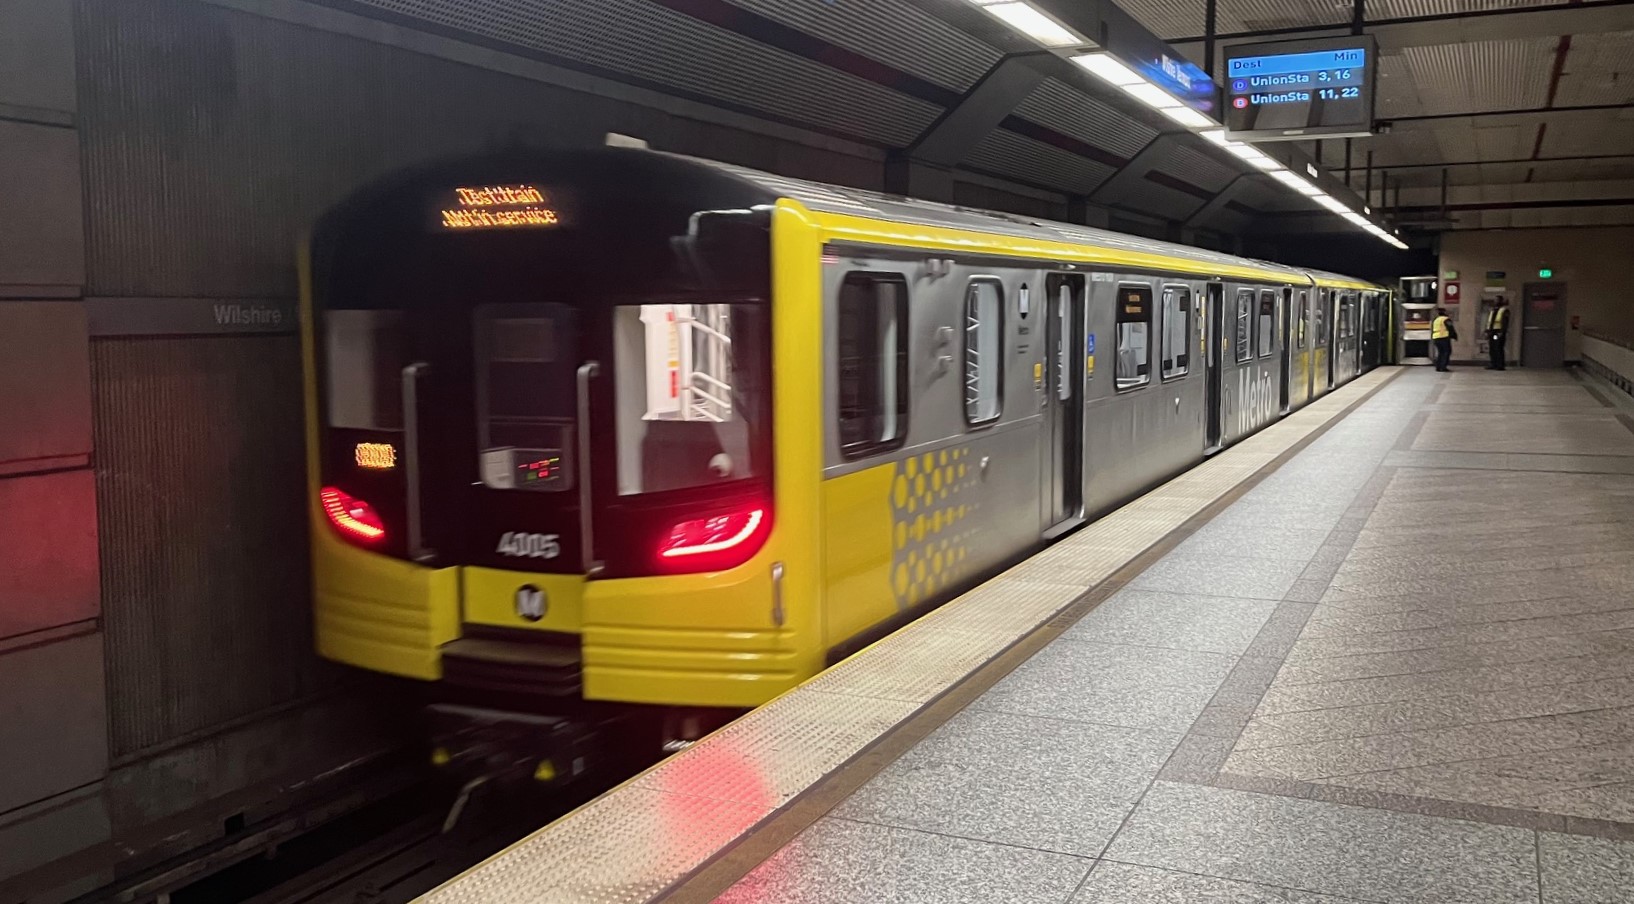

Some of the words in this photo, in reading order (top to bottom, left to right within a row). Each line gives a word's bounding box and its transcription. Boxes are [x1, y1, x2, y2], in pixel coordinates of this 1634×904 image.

[1233, 60, 1262, 69] Dest
[1334, 52, 1358, 61] Min
[1250, 73, 1310, 86] UnionSta
[1318, 72, 1331, 82] 3,
[1334, 69, 1351, 79] 16
[1250, 92, 1310, 104] UnionSta
[1319, 89, 1339, 99] 11,
[1341, 87, 1359, 98] 22
[496, 206, 558, 225] service
[213, 304, 282, 324] Wilshire
[1238, 365, 1272, 434] Metro
[495, 531, 560, 559] 4005
